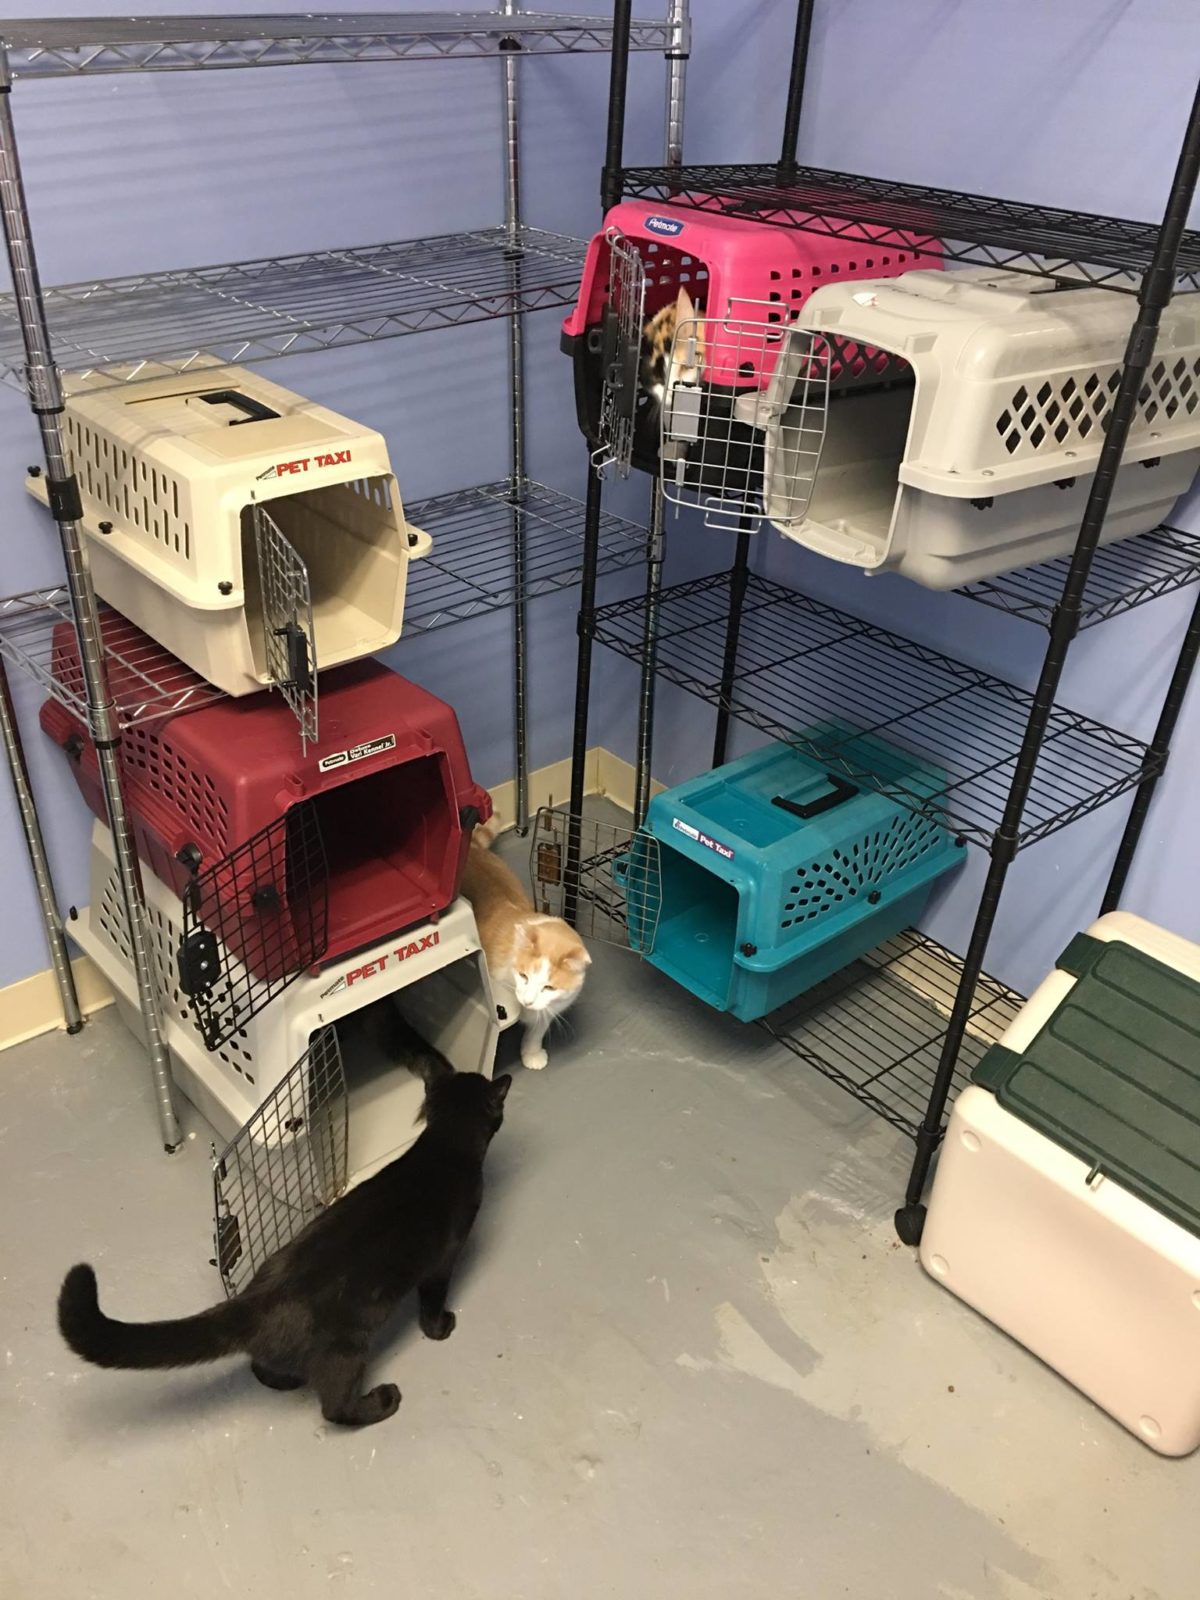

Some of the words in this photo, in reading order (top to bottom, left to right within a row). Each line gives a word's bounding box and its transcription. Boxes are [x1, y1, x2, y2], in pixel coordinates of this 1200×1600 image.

[648, 218, 678, 232] Petmate
[276, 458, 310, 477] PET
[314, 450, 352, 467] TAXI
[363, 743, 384, 755] Kennel
[700, 835, 714, 849] Pet
[715, 842, 734, 859] Taxi
[346, 954, 389, 987] PET
[393, 931, 440, 962] TAXI
